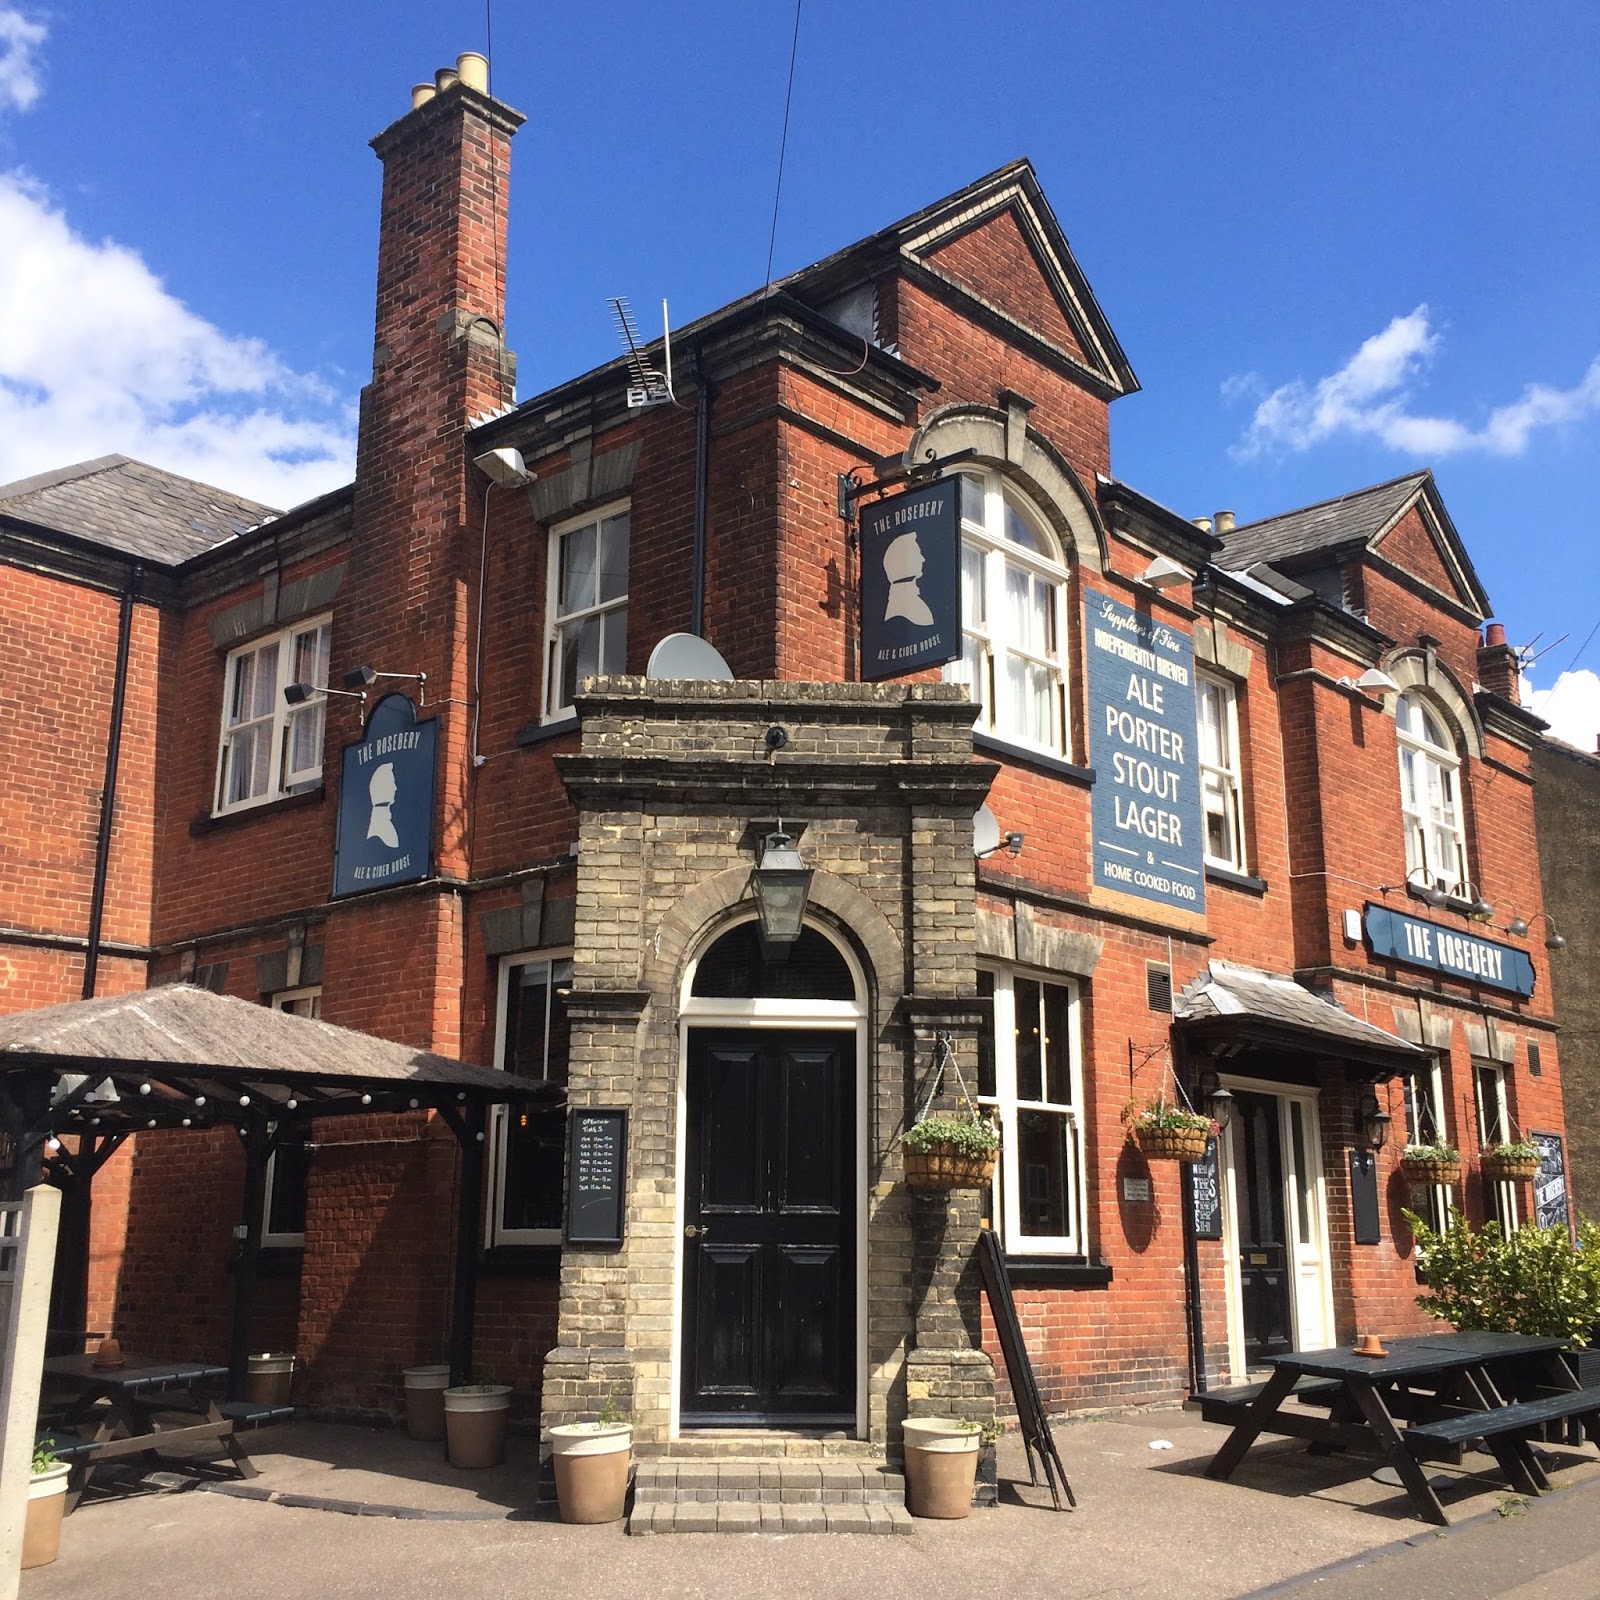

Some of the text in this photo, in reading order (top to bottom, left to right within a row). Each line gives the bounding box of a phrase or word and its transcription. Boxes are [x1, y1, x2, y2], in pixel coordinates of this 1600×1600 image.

[873, 500, 944, 536] THE ROSEBERY
[878, 648, 890, 661] ALE
[899, 644, 918, 659] CIDER
[920, 633, 941, 653] HOUSE
[1099, 600, 1147, 637] Suppliers
[1158, 630, 1181, 653] Fine
[1094, 627, 1189, 687] INDEPENDENTLY BREWED
[1126, 673, 1164, 715] ALE
[358, 731, 421, 765] THE ROSEBERY
[1106, 705, 1184, 765] PORTER
[1113, 752, 1180, 803] STOUT
[1114, 796, 1182, 847] LAGER
[354, 866, 365, 879] ALE
[371, 863, 390, 878] CIDER
[391, 854, 411, 874] HOUSE
[1147, 851, 1154, 865] &
[1104, 861, 1196, 900] HOME COOKED FOOD
[1404, 922, 1502, 981] THE ROSEBERY
